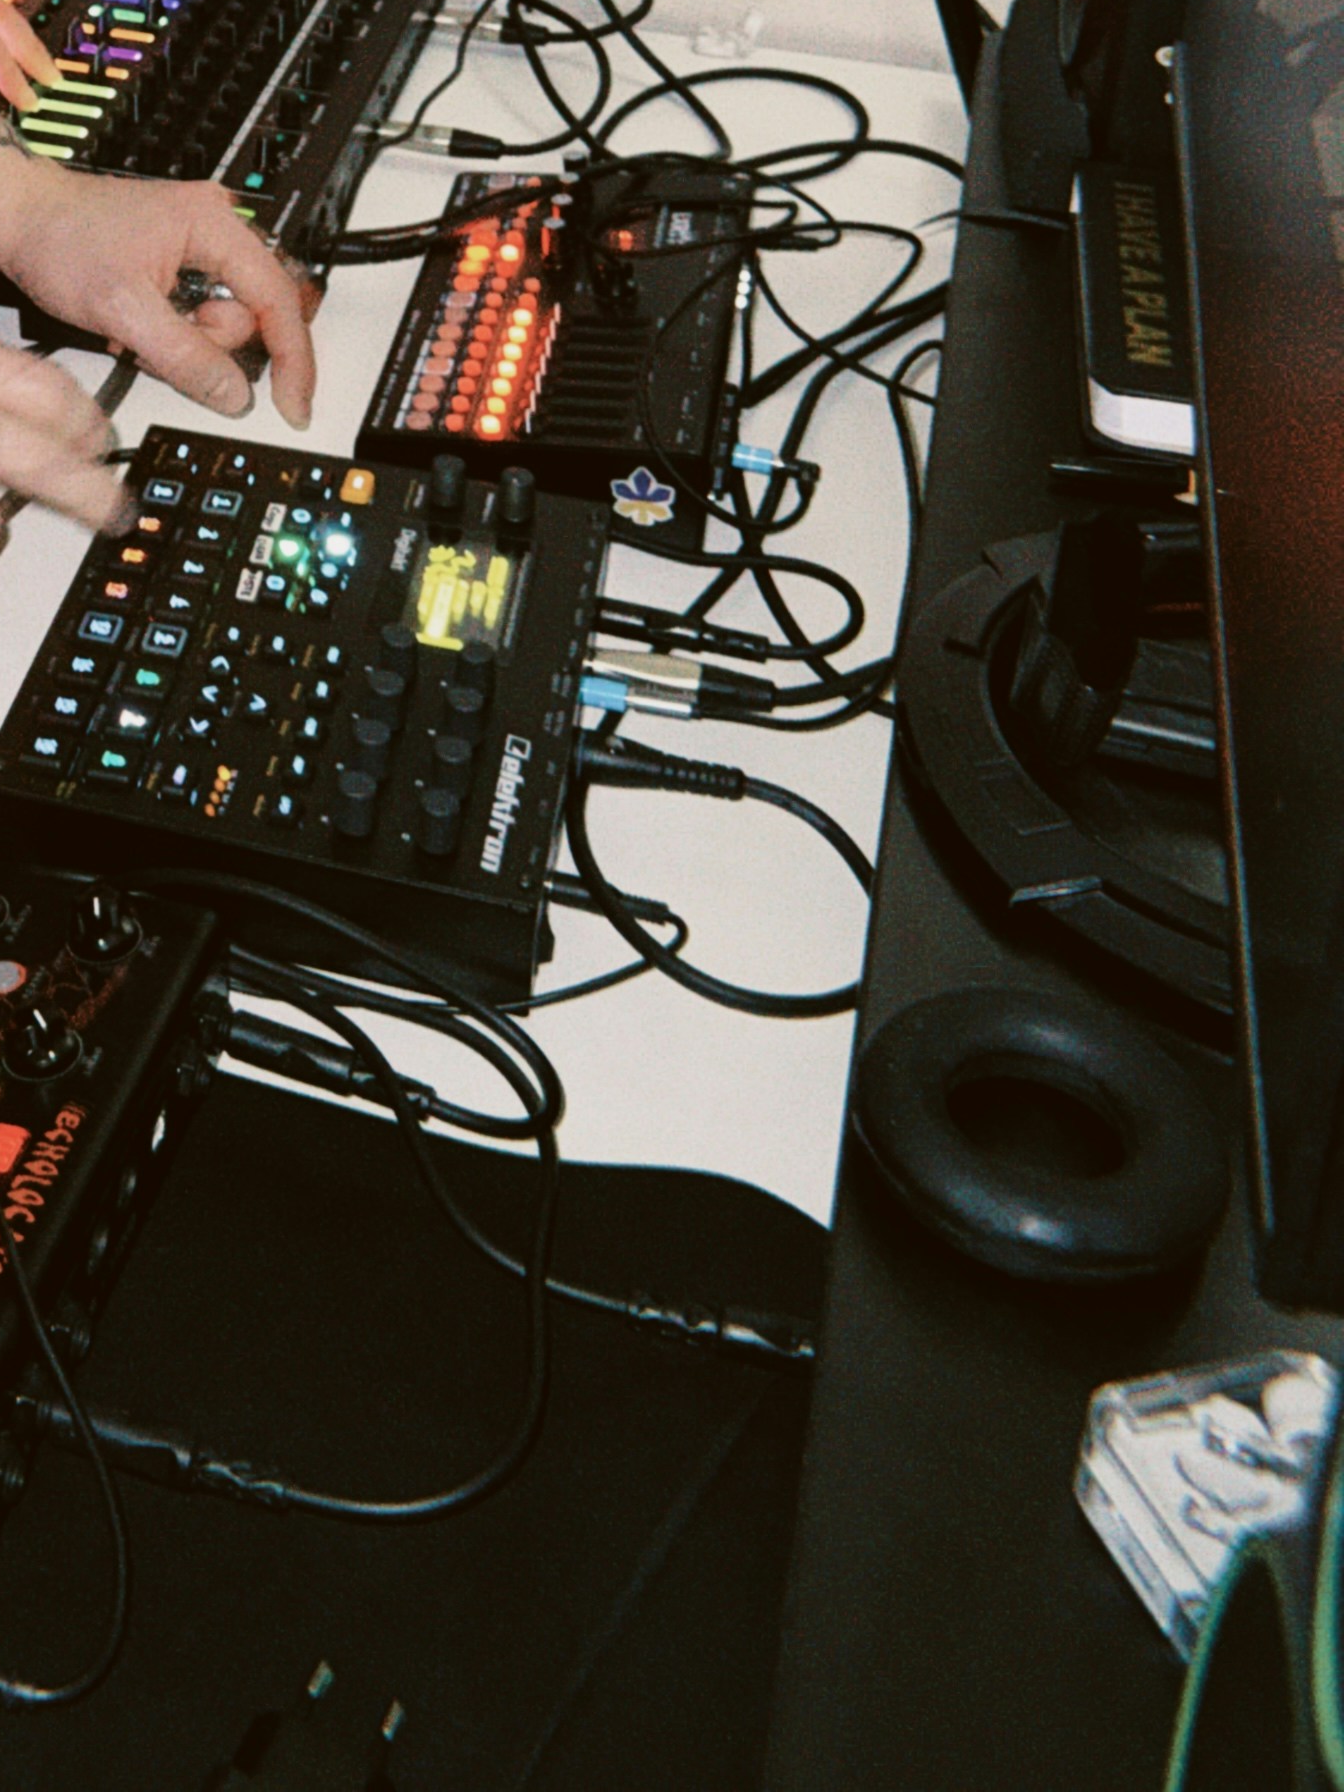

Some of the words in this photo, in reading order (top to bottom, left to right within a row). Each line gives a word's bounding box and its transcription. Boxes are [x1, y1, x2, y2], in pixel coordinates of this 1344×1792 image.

[1115, 190, 1161, 265] HAVE
[1120, 260, 1163, 288] A
[1124, 288, 1171, 368] PLAN
[389, 527, 417, 572] Digitakt
[480, 755, 525, 873] elektron
